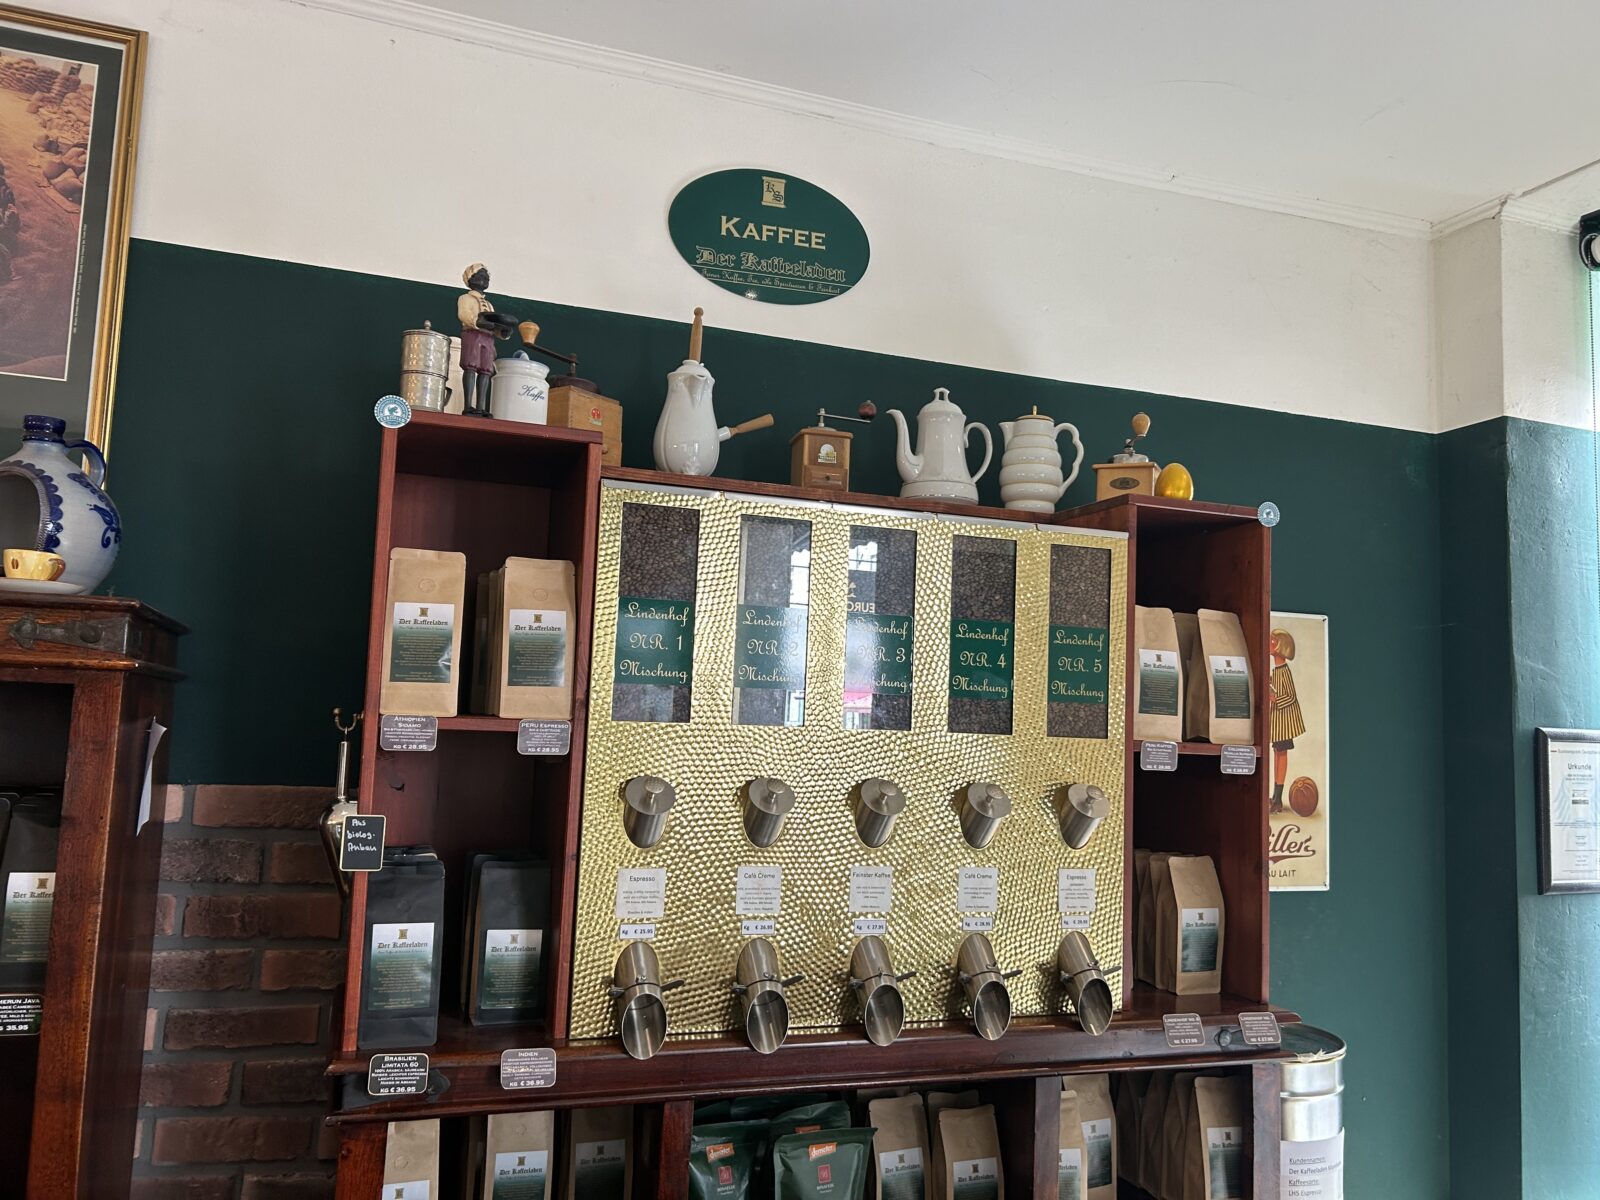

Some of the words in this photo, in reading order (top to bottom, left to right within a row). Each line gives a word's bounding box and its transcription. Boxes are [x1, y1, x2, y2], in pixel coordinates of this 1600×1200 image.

[720, 215, 827, 251] KAFFEE
[695, 245, 736, 268] Der
[740, 251, 847, 283] Kaffeeladen
[413, 618, 449, 626] Kaffeeladen
[624, 602, 690, 627] Lindenhof
[528, 624, 562, 632] Kaffeeladen
[955, 623, 1010, 646] Lindenhof
[629, 632, 668, 651] NR.
[676, 635, 683, 651] 1
[1052, 629, 1105, 652] Lindenhof
[788, 641, 800, 657] 2
[896, 647, 906, 663] 3
[959, 651, 993, 669] NR.
[997, 653, 1007, 669] 4
[1057, 656, 1089, 673] NR.
[1093, 658, 1103, 673] 5
[619, 659, 689, 684] Mischung
[952, 675, 1009, 699] Mischung
[1051, 680, 1105, 703] Mischung
[629, 875, 656, 883] Espresso
[1278, 869, 1297, 878] LAIT
[12, 891, 28, 899] Der
[29, 891, 54, 899] Kaffee
[391, 941, 428, 949] Kaffeeladen
[811, 1146, 833, 1156] demeter
[512, 1167, 543, 1175] Kaffeeladen
[1300, 1166, 1328, 1175] Kaffeeladen
